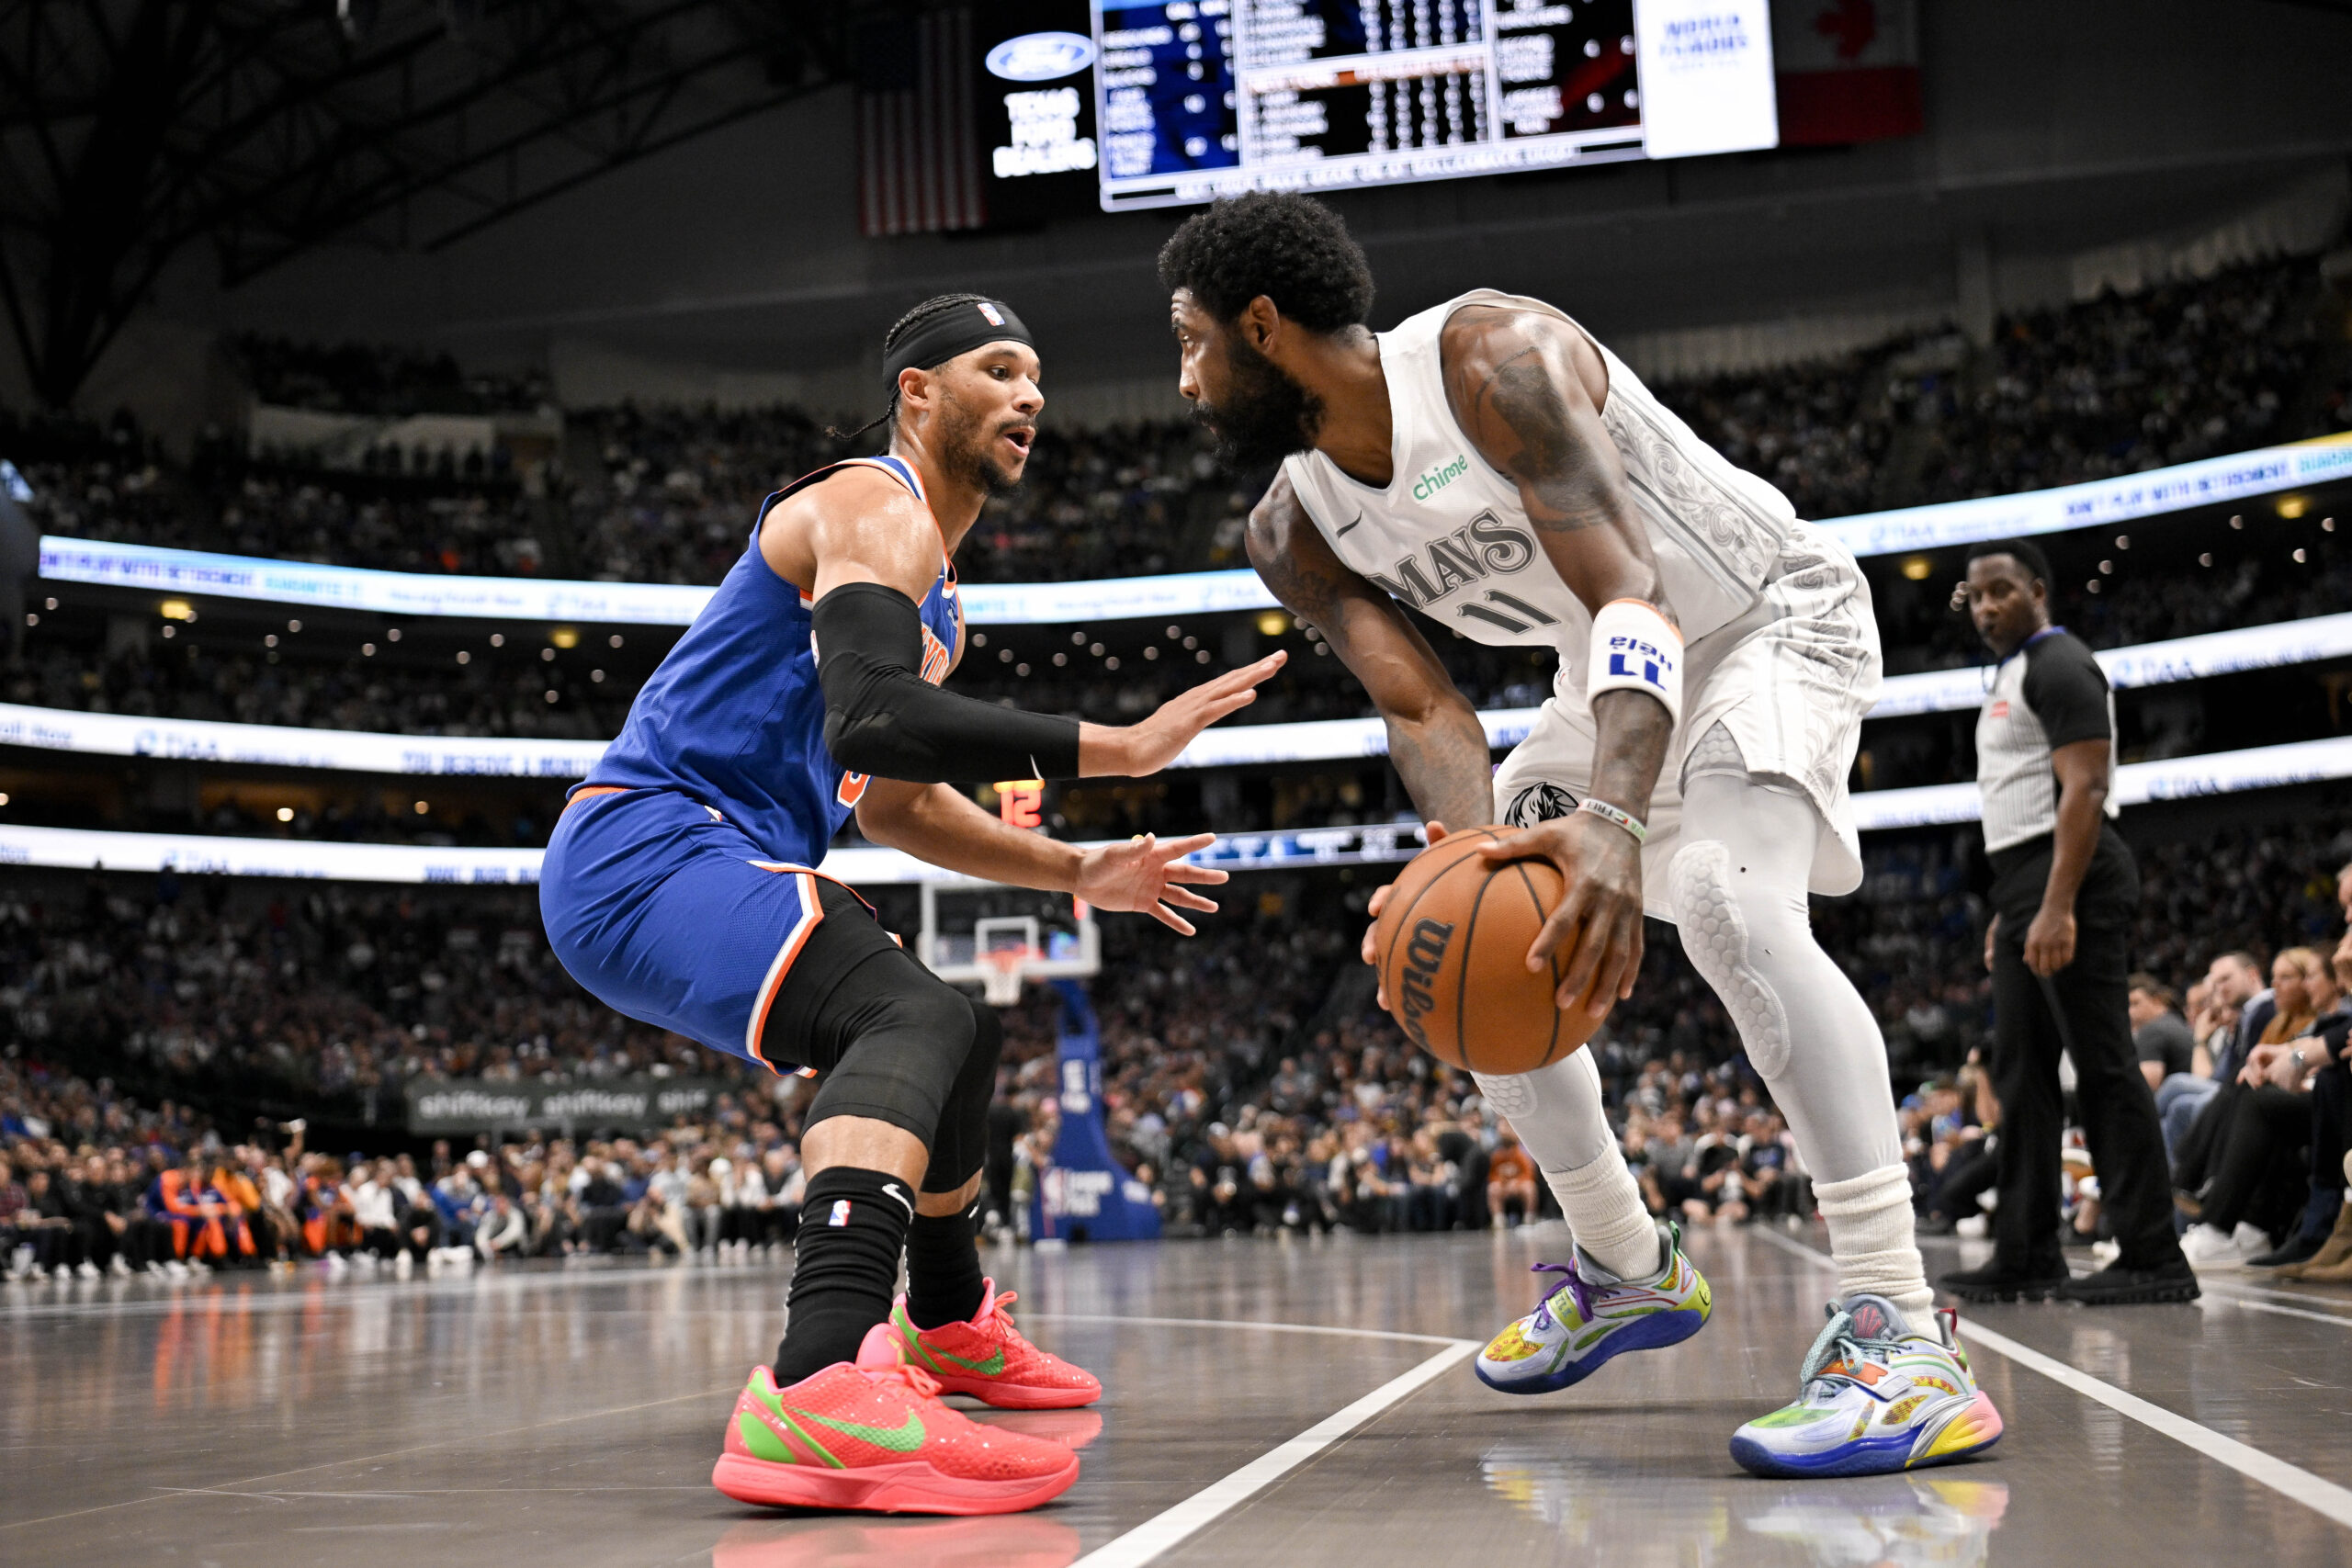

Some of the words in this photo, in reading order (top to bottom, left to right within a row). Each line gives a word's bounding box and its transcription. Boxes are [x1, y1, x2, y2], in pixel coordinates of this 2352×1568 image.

[1413, 454, 1468, 501] chime
[1365, 508, 1536, 610] MAVS
[1456, 589, 1561, 635] 11
[1401, 917, 1455, 1055] Wilso
